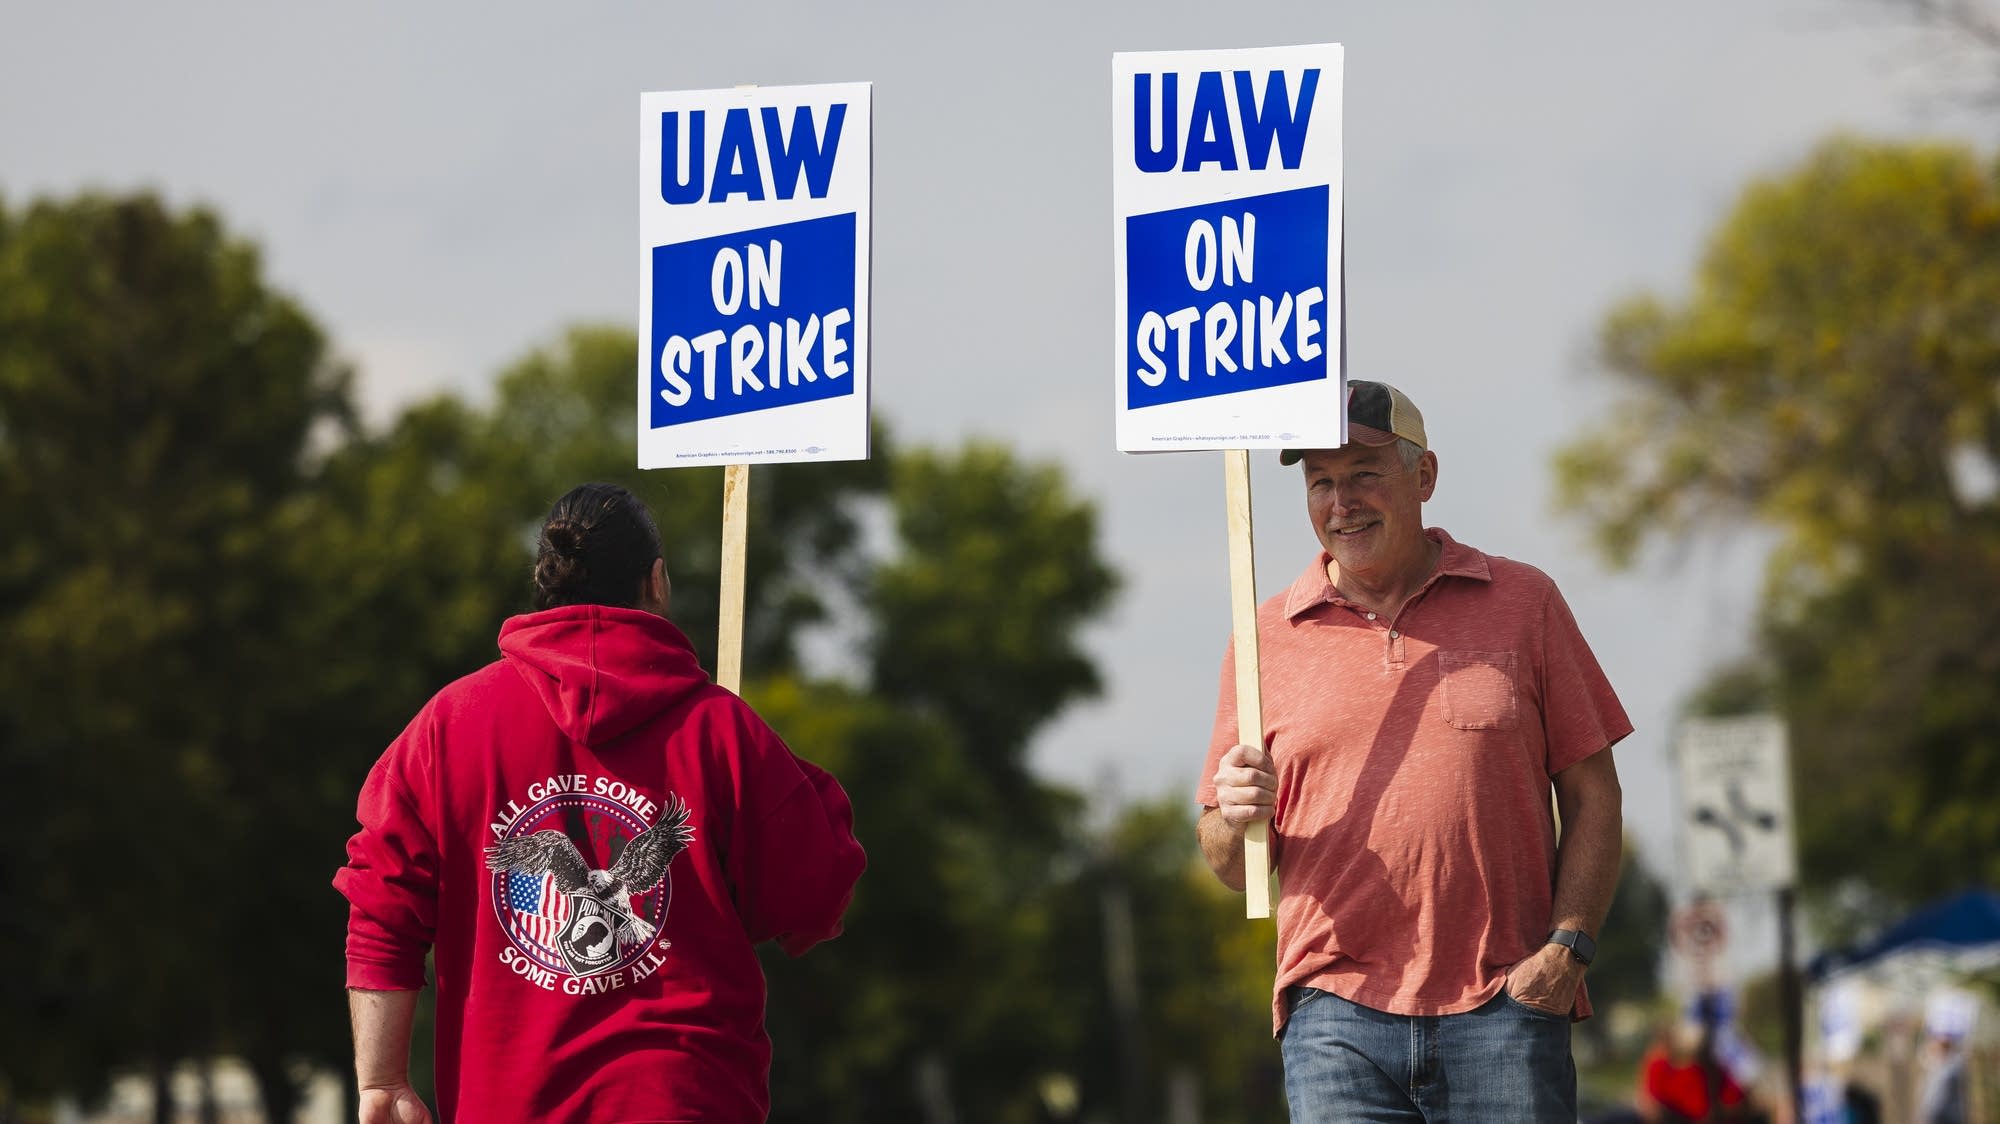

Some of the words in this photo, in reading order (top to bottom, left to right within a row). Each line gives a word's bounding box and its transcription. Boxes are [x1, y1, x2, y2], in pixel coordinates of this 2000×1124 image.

[661, 104, 847, 205] UAW
[1135, 69, 1320, 172] UAW
[712, 240, 782, 315] ON
[1185, 212, 1255, 291] ON
[661, 308, 850, 406] STRIKE
[1137, 287, 1323, 386] STRIKE
[491, 800, 527, 840] ALL
[528, 774, 588, 801] GAVE
[593, 777, 657, 821] SOME
[499, 946, 558, 991] SOME
[562, 972, 625, 996] GAVE
[632, 952, 667, 984] ALL
